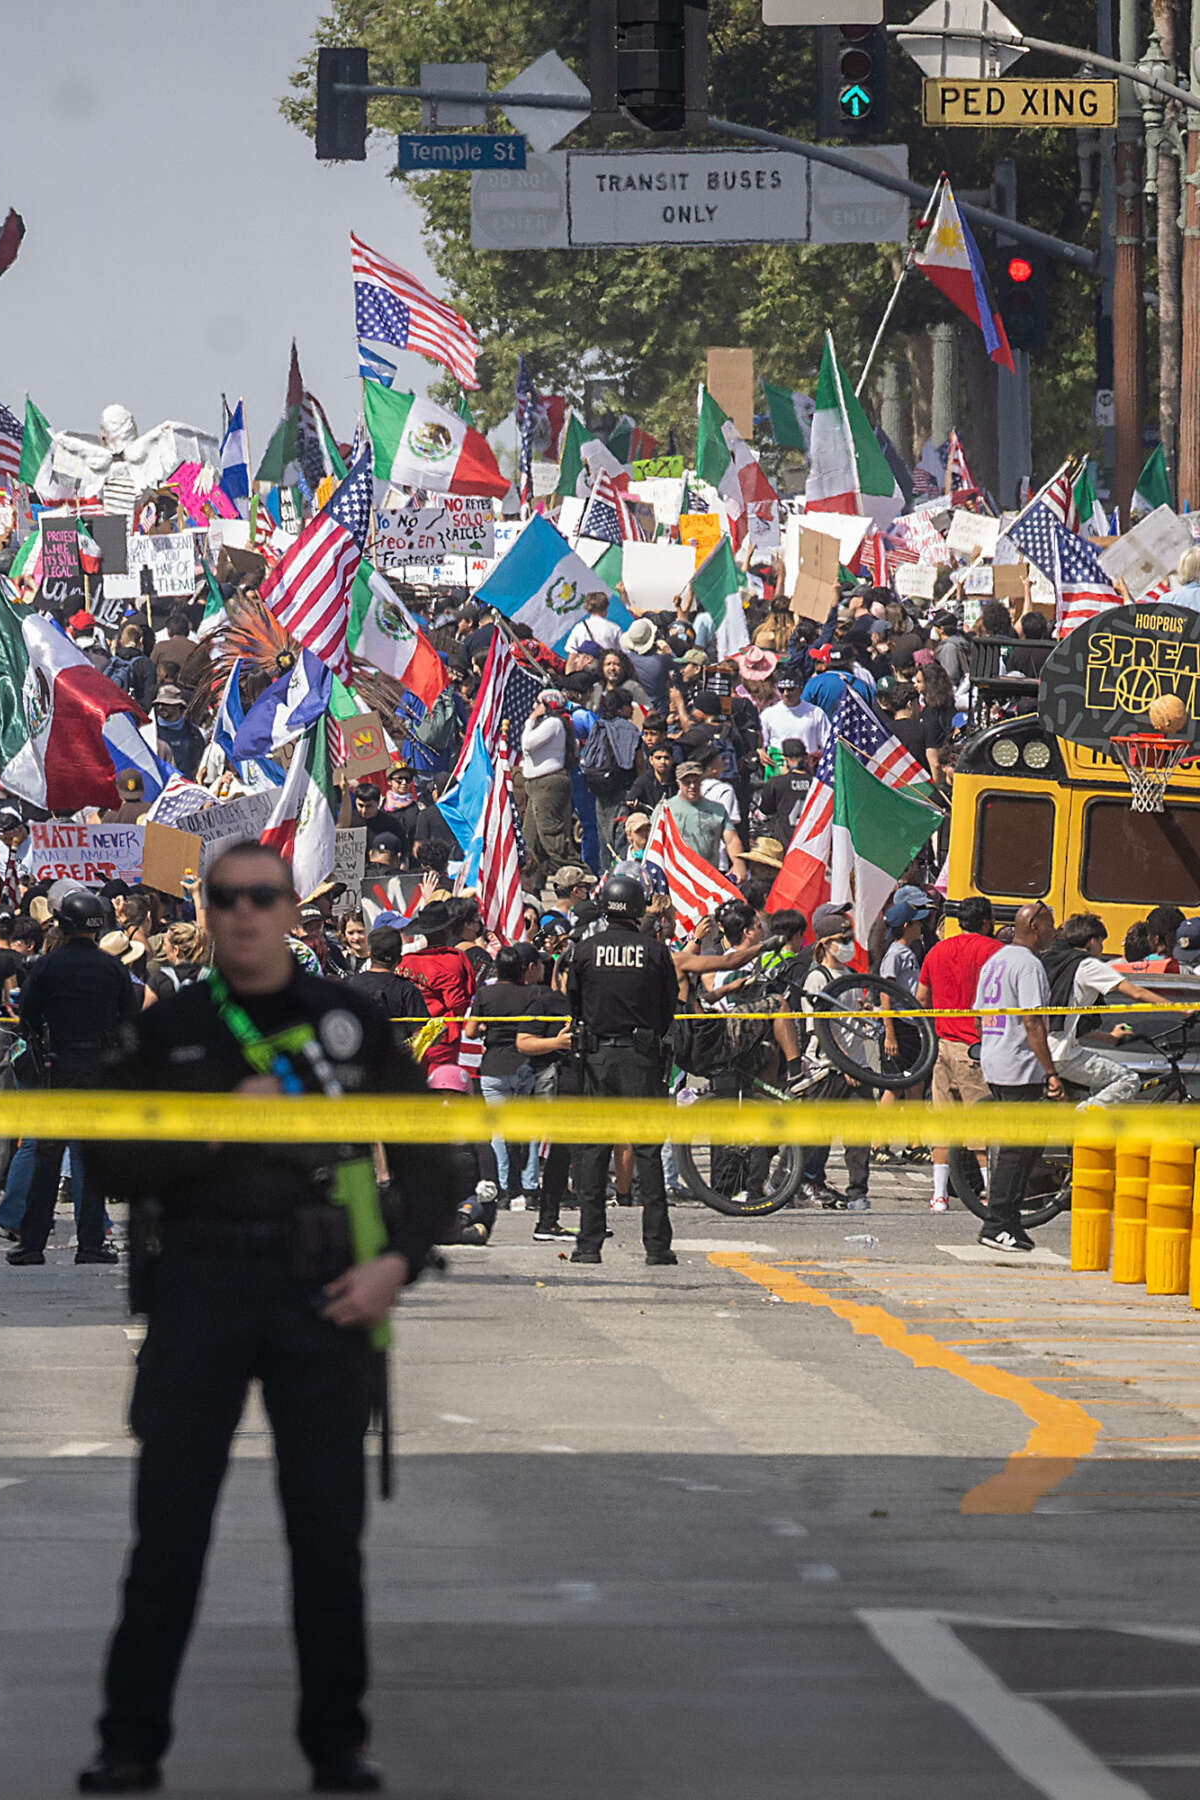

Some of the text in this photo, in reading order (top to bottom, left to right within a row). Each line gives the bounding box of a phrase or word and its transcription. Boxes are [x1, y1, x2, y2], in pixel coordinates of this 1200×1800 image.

[941, 87, 1098, 117] PED XING
[408, 142, 516, 164] Temple St
[596, 170, 782, 192] TRANSIT BUSES
[663, 204, 719, 224] ONLY
[444, 498, 492, 512] NO REYES
[452, 512, 482, 527] SOLO
[46, 531, 78, 543] PROTEST
[46, 566, 73, 578] LEGAL
[31, 823, 140, 849] HATE NEVER
[37, 862, 117, 882] GREAT
[596, 945, 645, 968] POLICE
